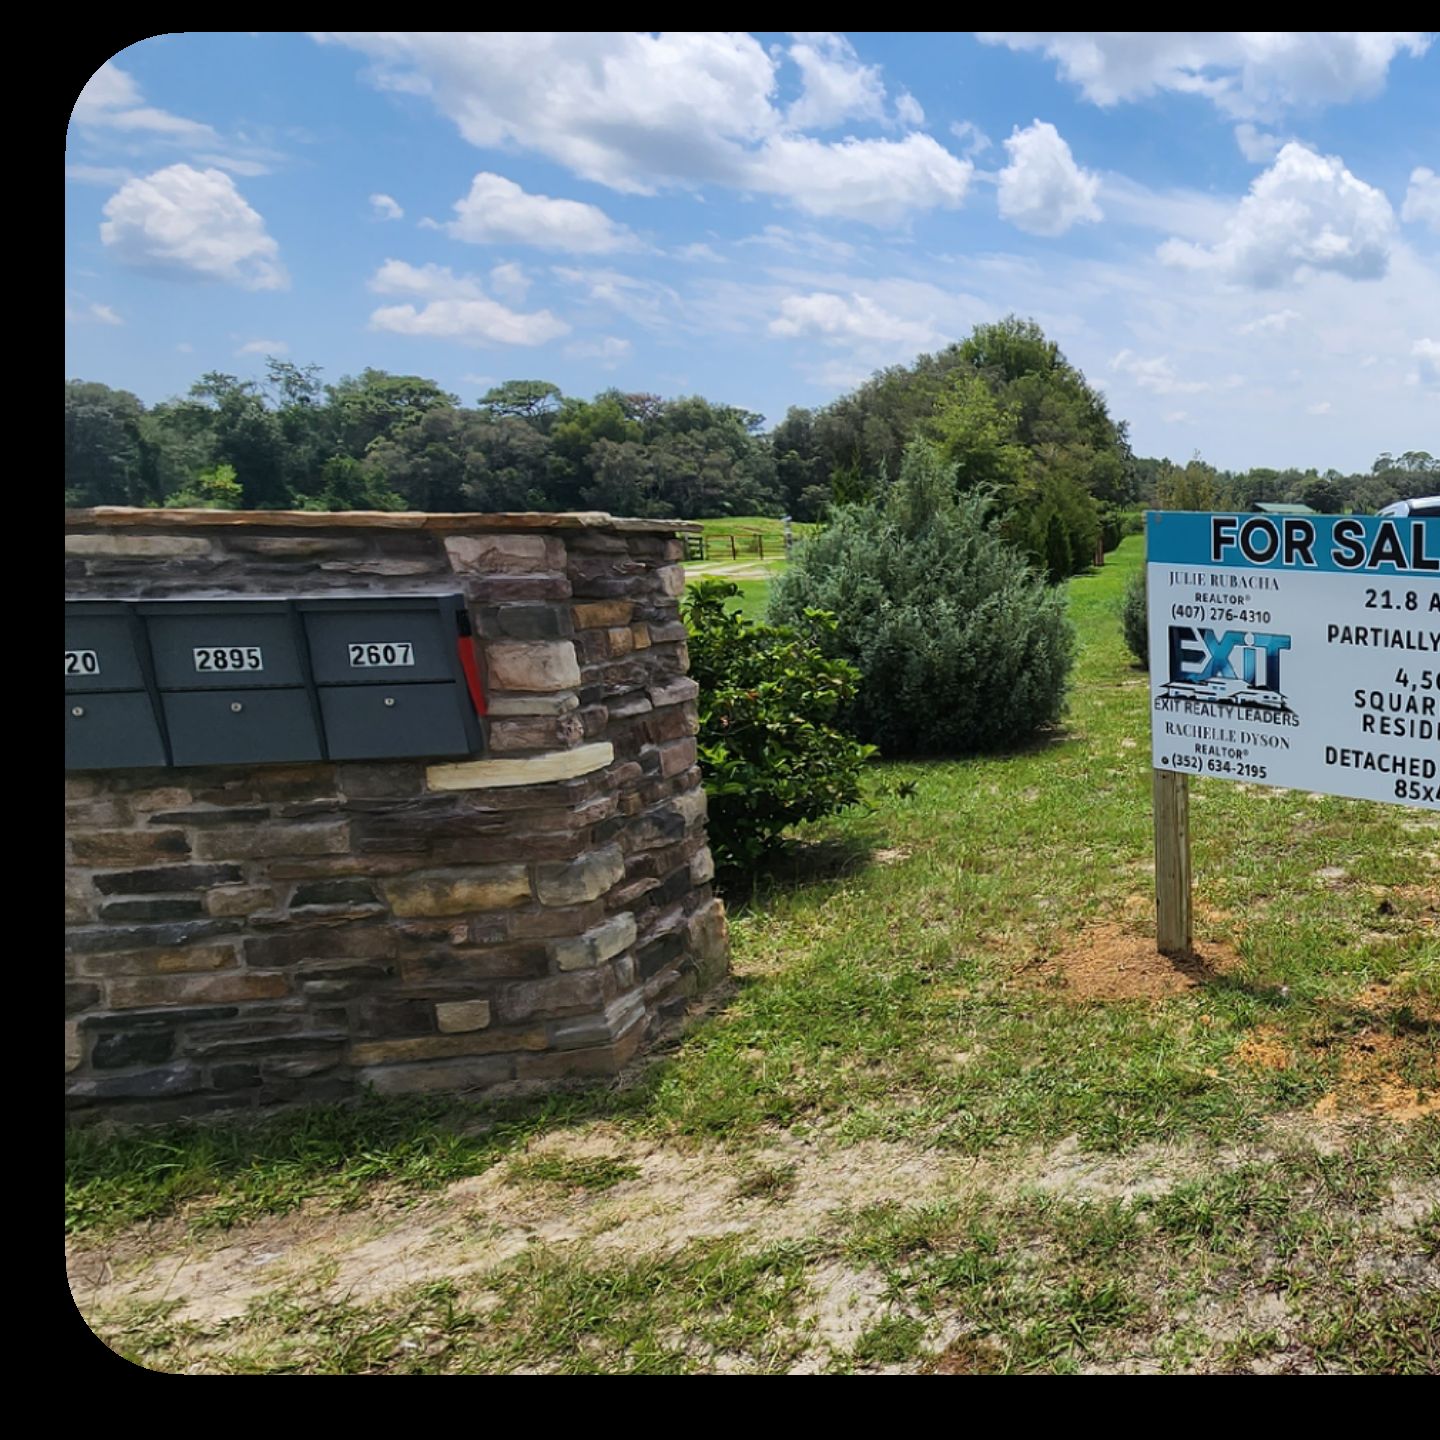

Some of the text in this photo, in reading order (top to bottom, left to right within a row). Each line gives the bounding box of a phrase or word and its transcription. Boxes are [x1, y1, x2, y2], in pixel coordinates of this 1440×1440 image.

[1210, 516, 1317, 567] FOR
[1168, 571, 1280, 592] JULIE RUBACHA
[1365, 588, 1418, 611] 21.8
[1171, 604, 1271, 625] (407) 276-4310
[196, 648, 261, 671] 2895
[351, 644, 412, 666] 2607
[1154, 697, 1300, 728] EXIT REALTY LEADERS
[1165, 721, 1290, 750] RACHELLE DYSON
[1172, 753, 1268, 779] (352) 634-2195
[1325, 746, 1437, 779] DETACHED
